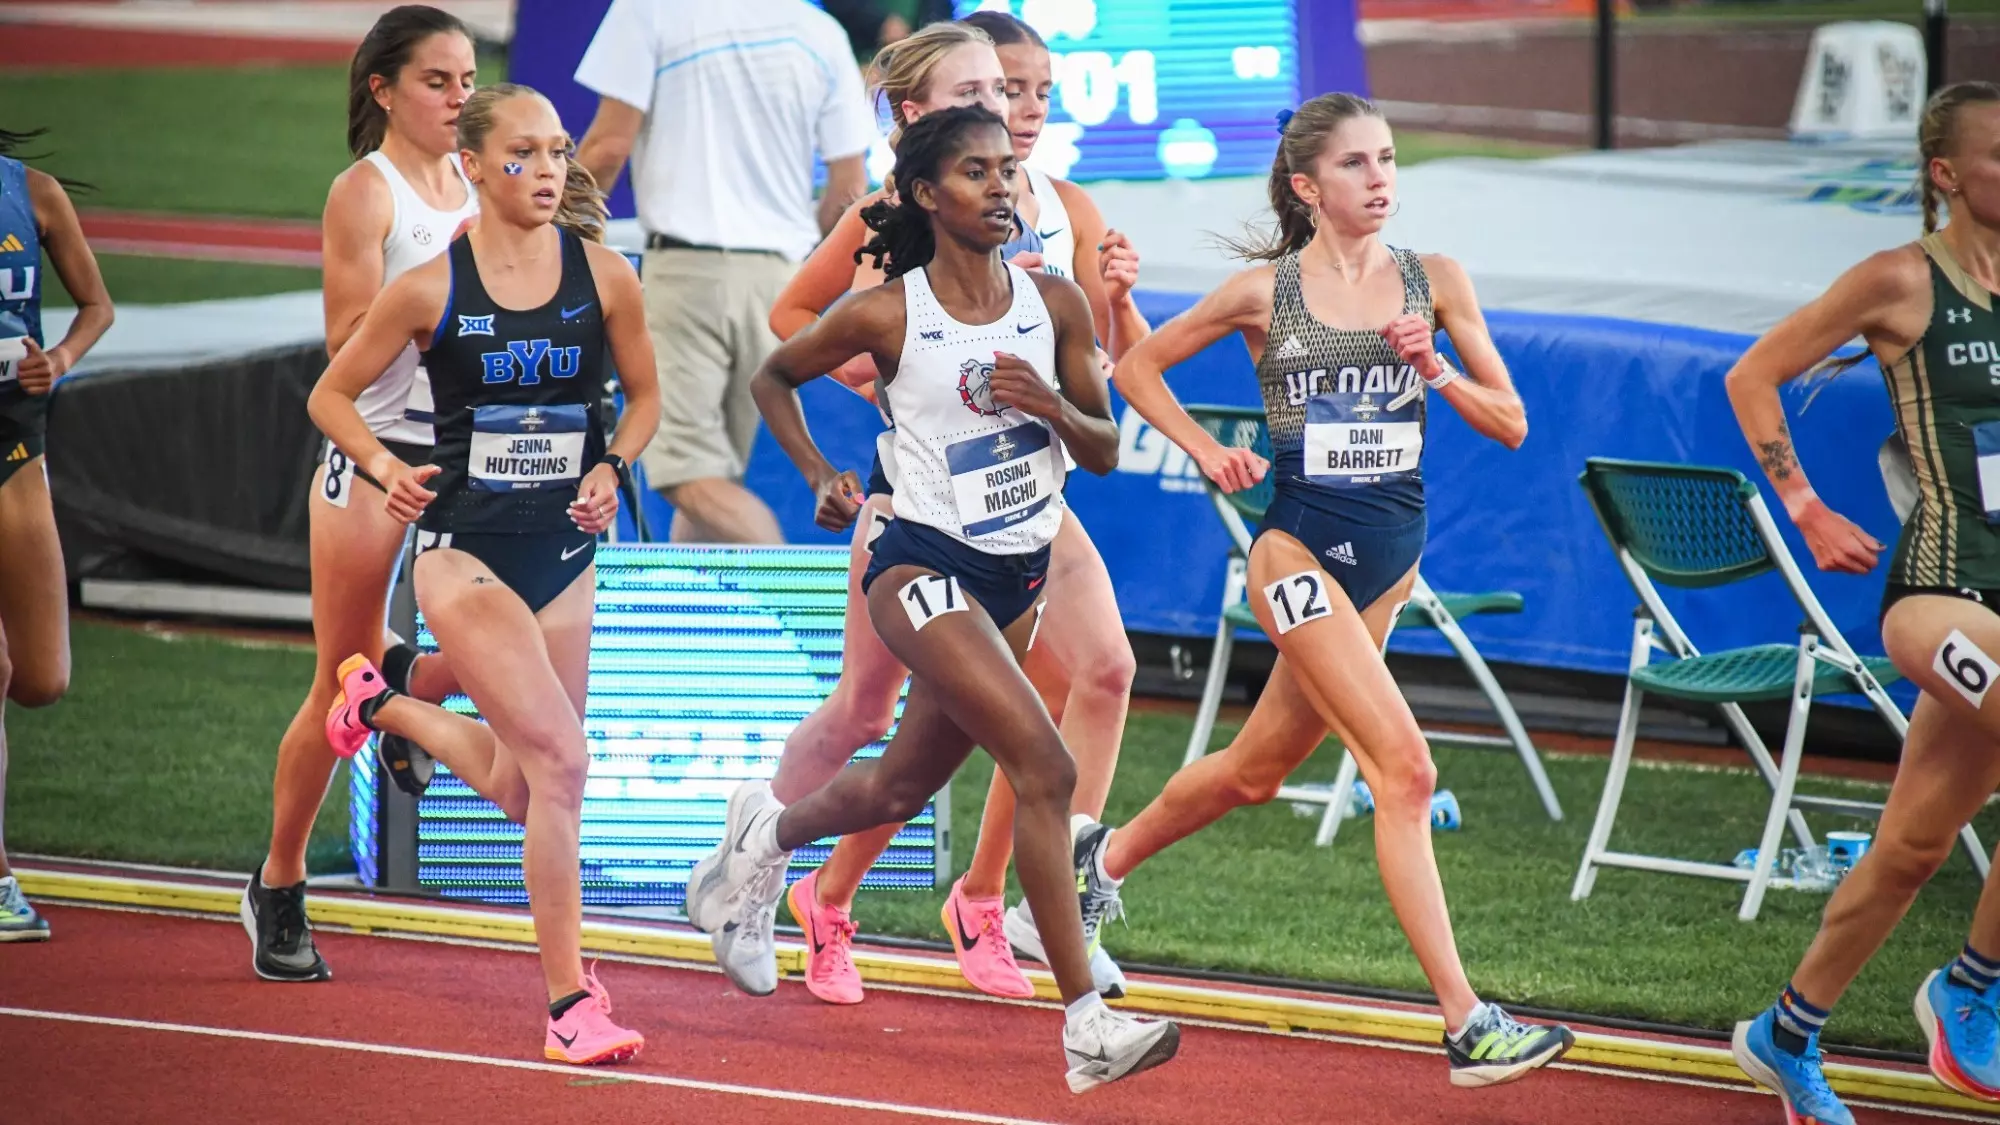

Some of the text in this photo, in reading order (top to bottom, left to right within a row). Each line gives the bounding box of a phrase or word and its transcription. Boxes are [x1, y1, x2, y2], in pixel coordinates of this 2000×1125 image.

[463, 318, 491, 332] XII
[481, 339, 581, 385] BYU
[507, 439, 552, 454] JENNA
[1349, 429, 1383, 445] DANI
[485, 456, 568, 475] HUTCHINS
[1328, 448, 1404, 469] BARRETT
[326, 447, 346, 500] 8
[985, 461, 1031, 488] ROSINA
[984, 479, 1037, 513] MACHU
[1326, 549, 1357, 566] adidas
[907, 576, 954, 618] 17
[1273, 575, 1327, 626] 12
[1942, 642, 1988, 693] 6
